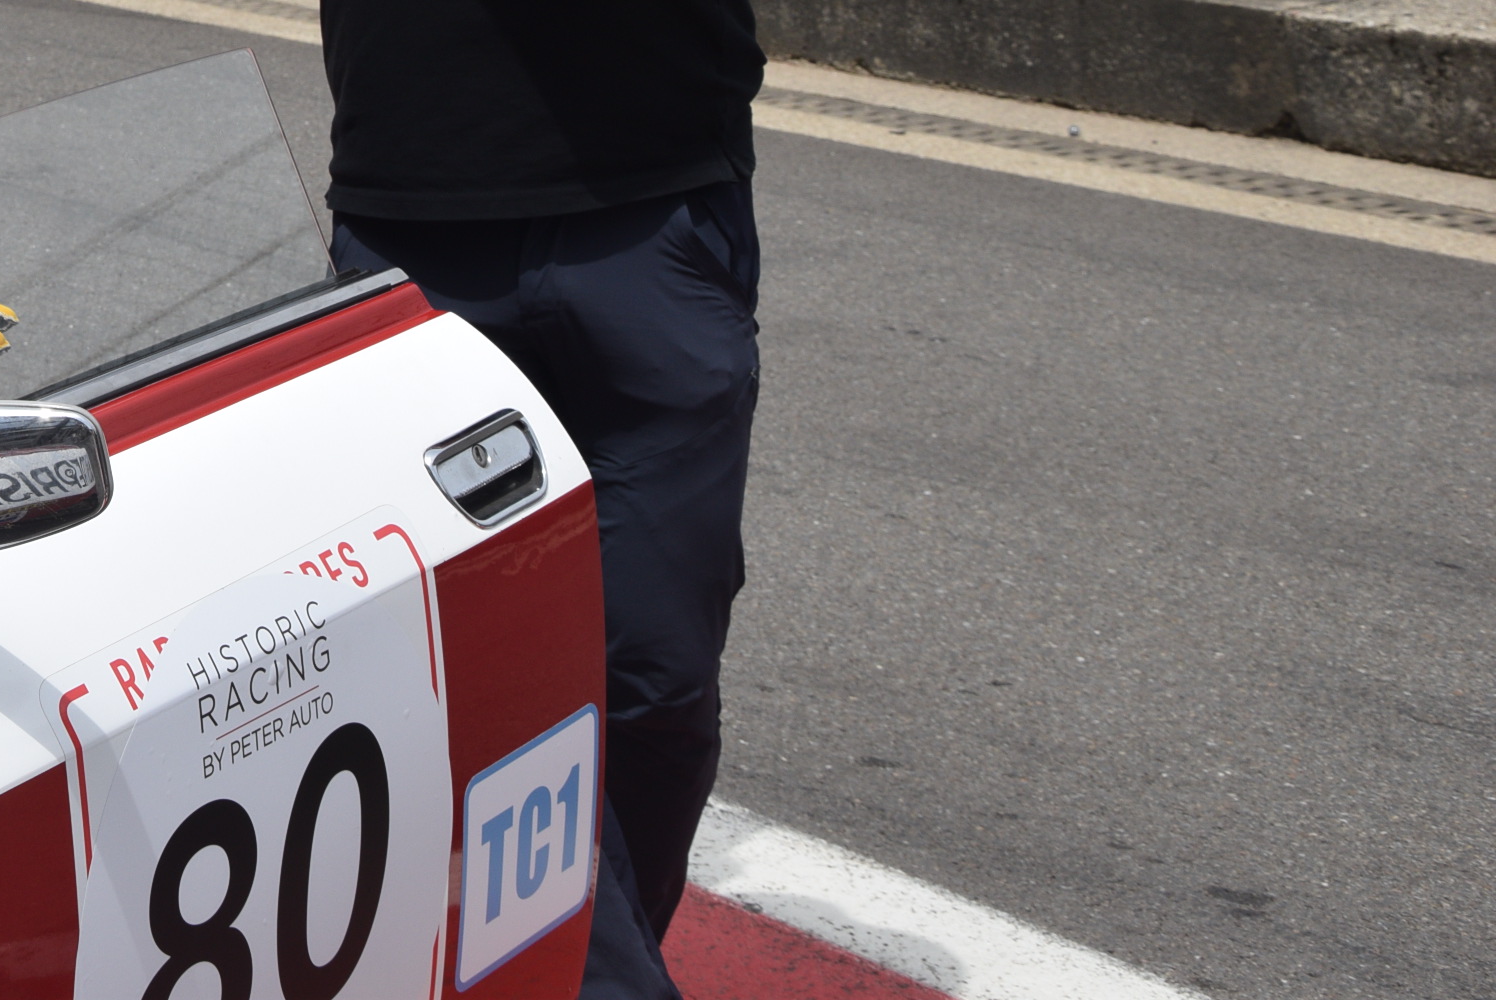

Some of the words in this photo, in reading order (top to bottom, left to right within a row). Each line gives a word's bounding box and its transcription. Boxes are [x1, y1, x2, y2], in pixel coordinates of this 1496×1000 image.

[186, 601, 326, 690] HISTORIC
[198, 636, 331, 733] RACING
[203, 746, 225, 779] BY
[231, 717, 284, 764] PETER
[289, 692, 333, 734] AUTO
[141, 722, 389, 1000] 80
[481, 762, 581, 926] TC1
